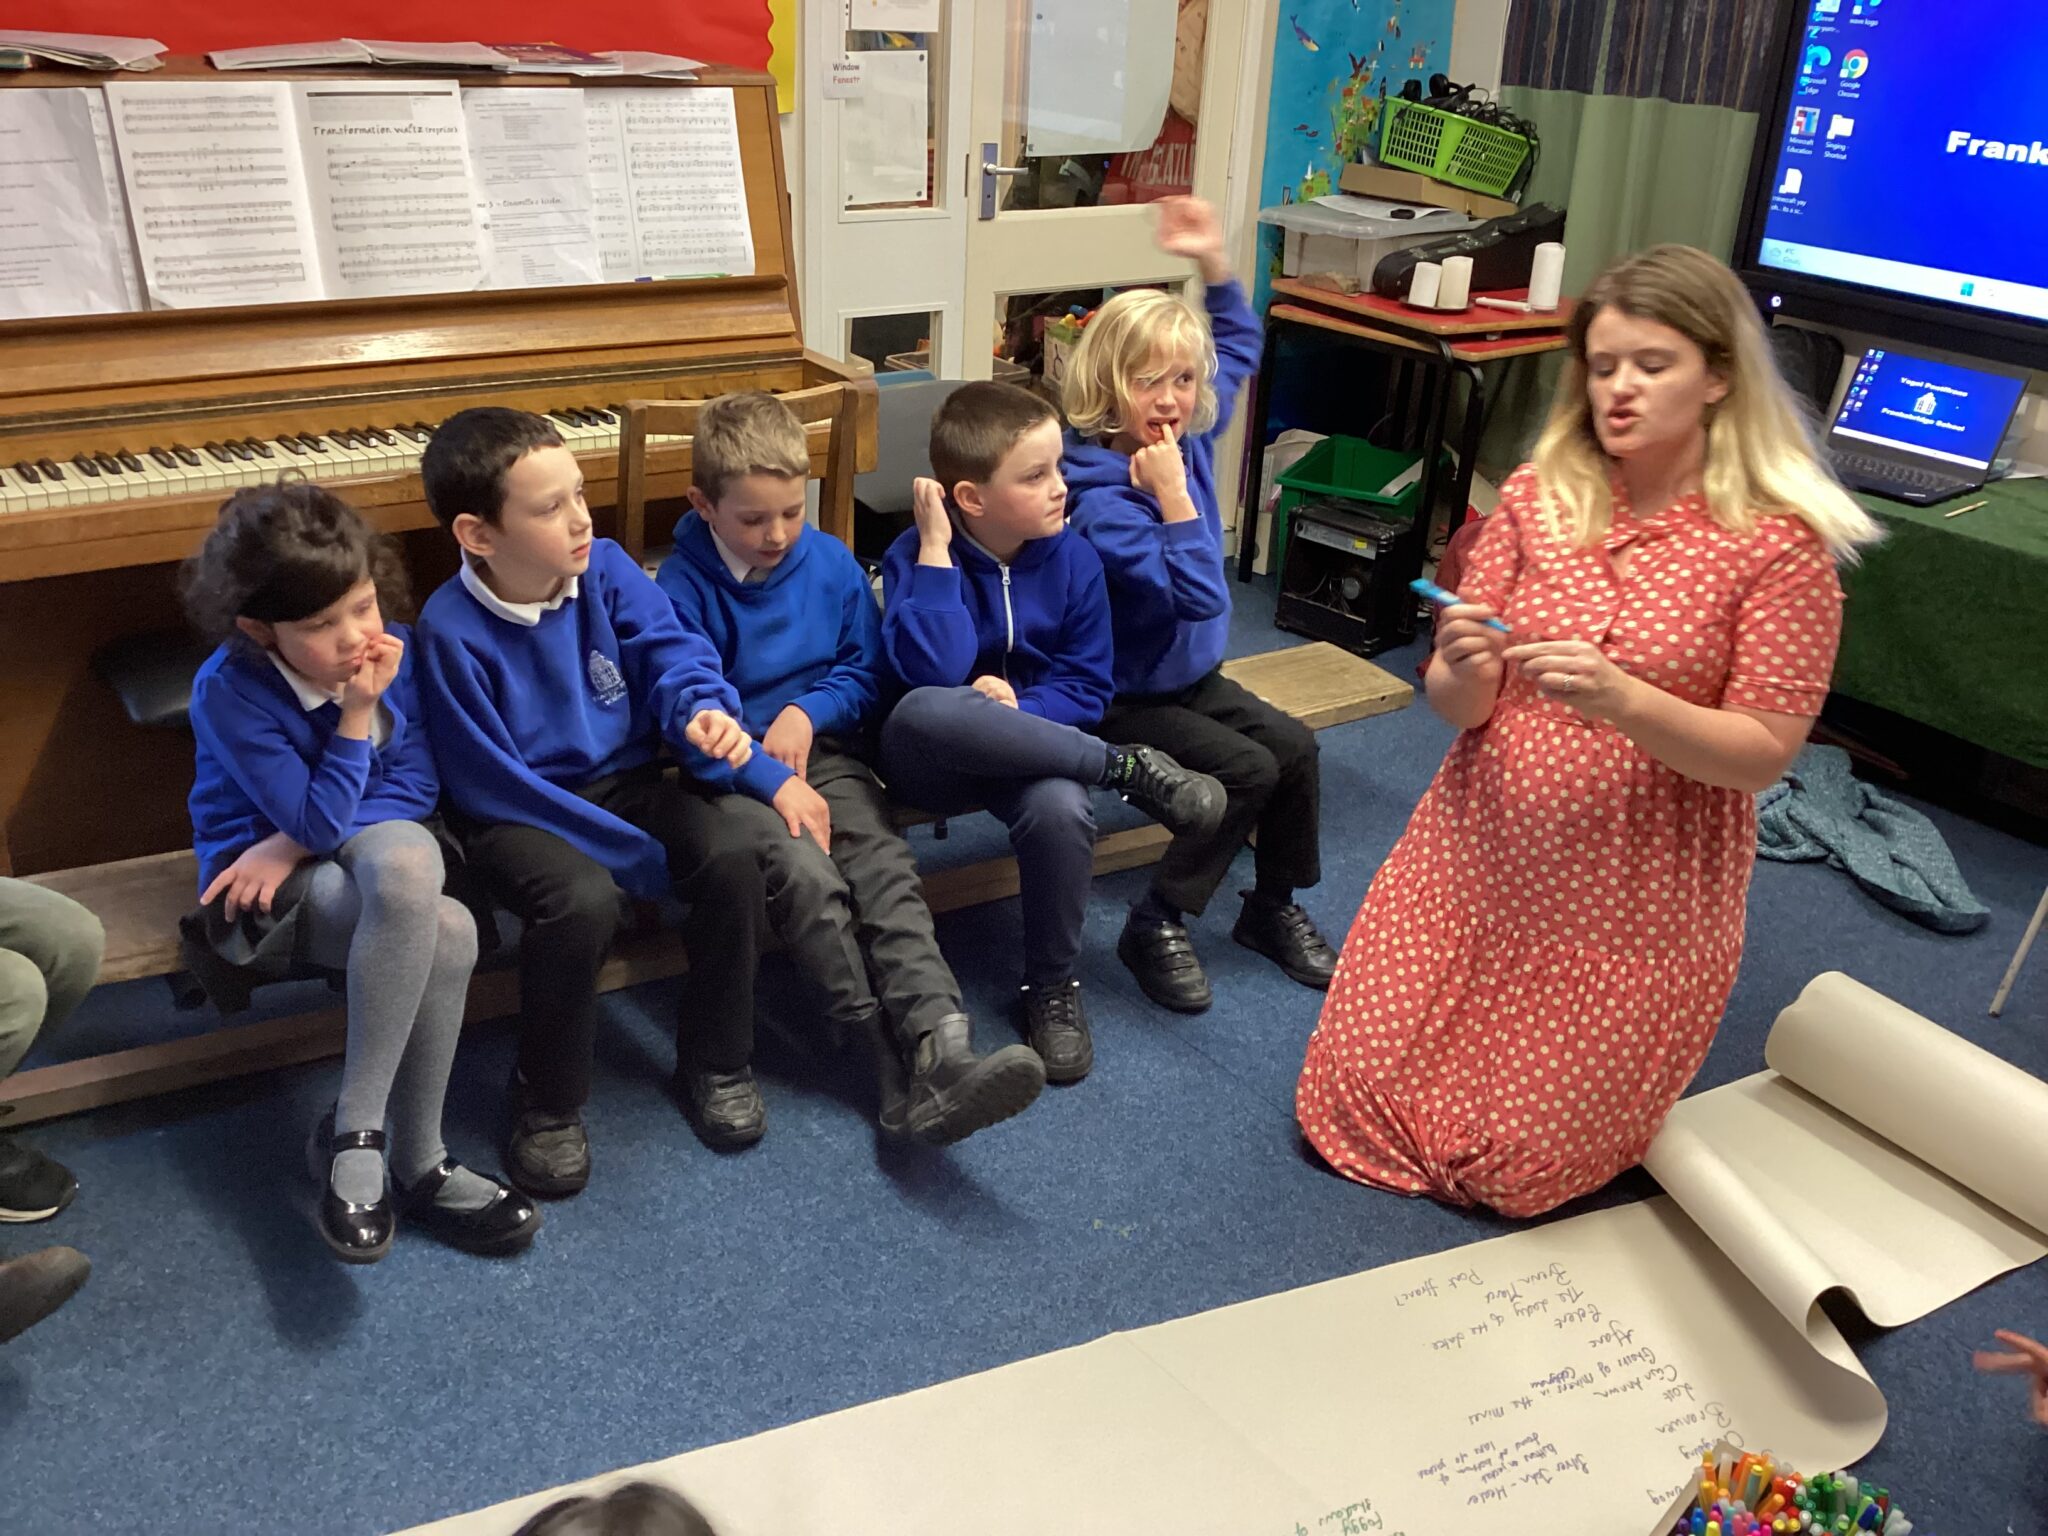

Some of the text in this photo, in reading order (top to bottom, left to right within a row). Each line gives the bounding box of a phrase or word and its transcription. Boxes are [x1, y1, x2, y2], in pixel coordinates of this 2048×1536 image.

[832, 63, 860, 71] Window
[1840, 81, 1861, 90] Google
[1837, 90, 1860, 99] Chrome
[313, 124, 392, 136] Transformation
[1787, 145, 1813, 155] Education
[1825, 141, 1846, 151] Singing
[1555, 1286, 1584, 1304] The
[1489, 1313, 1504, 1326] of
[1470, 1321, 1488, 1335] the
[1597, 1362, 1611, 1378] of
[1510, 1396, 1533, 1410] the
[1520, 1468, 1553, 1485] John
